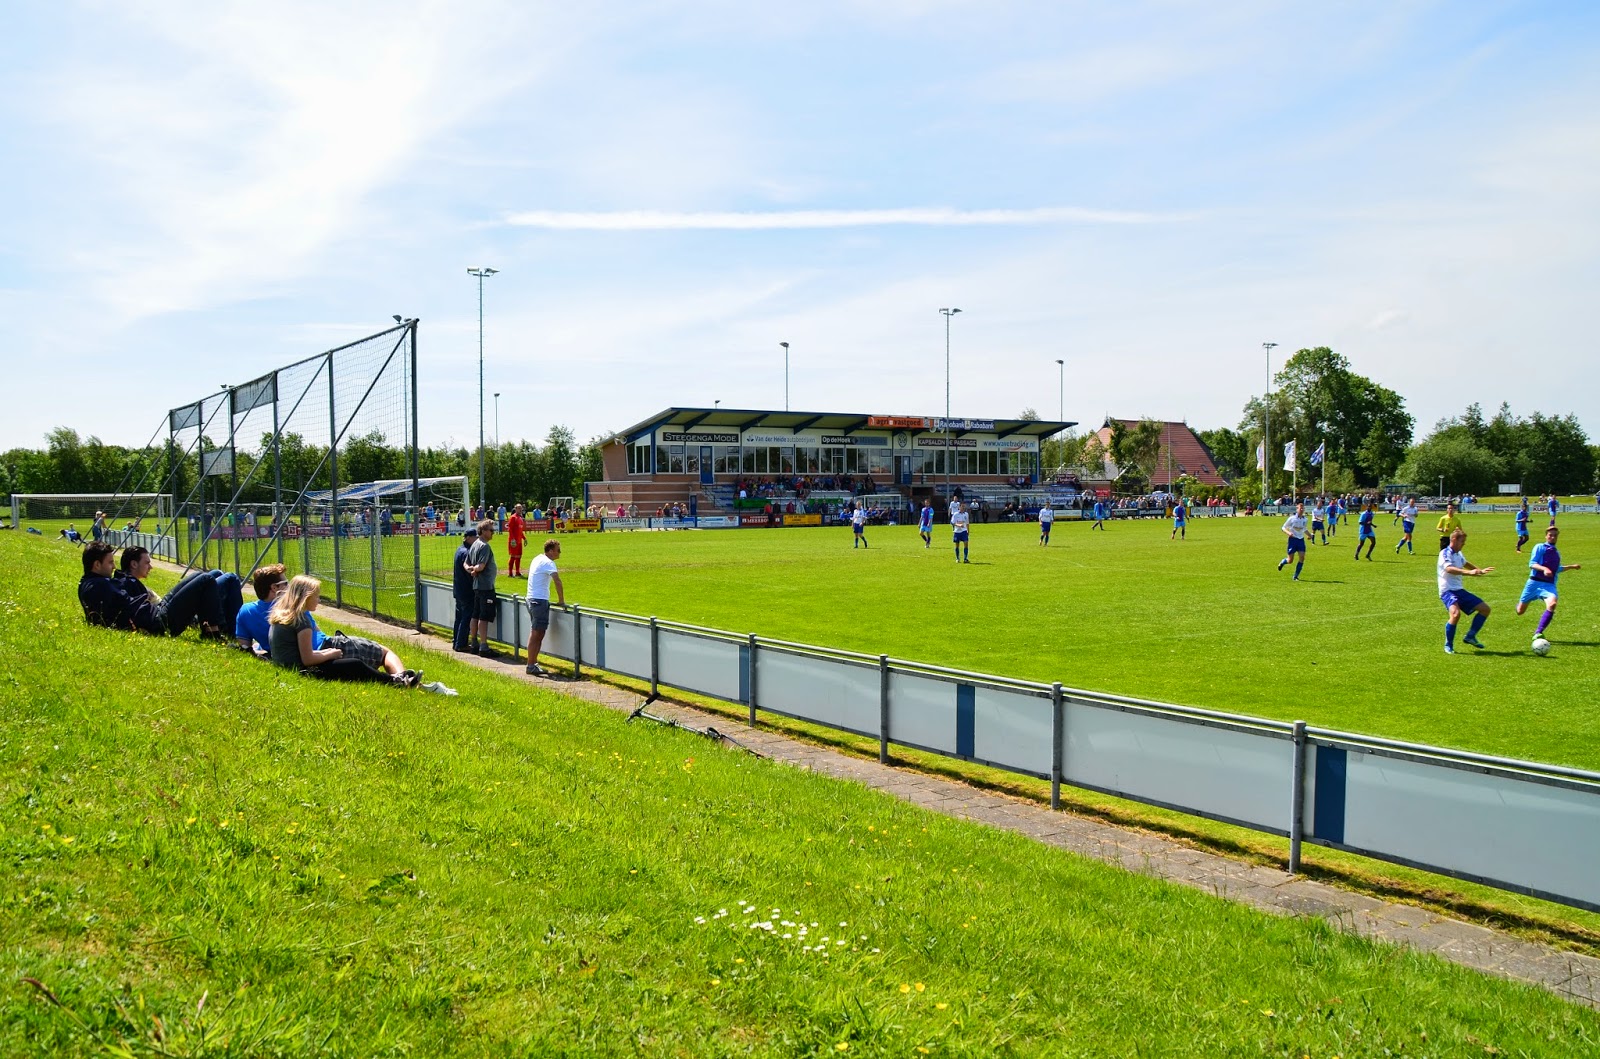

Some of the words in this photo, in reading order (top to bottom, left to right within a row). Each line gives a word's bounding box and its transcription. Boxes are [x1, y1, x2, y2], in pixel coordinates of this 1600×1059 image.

[940, 420, 965, 428] Raobank
[970, 421, 994, 429] Rabobank
[665, 433, 712, 442] STEEGENGA
[713, 434, 737, 442] MODE
